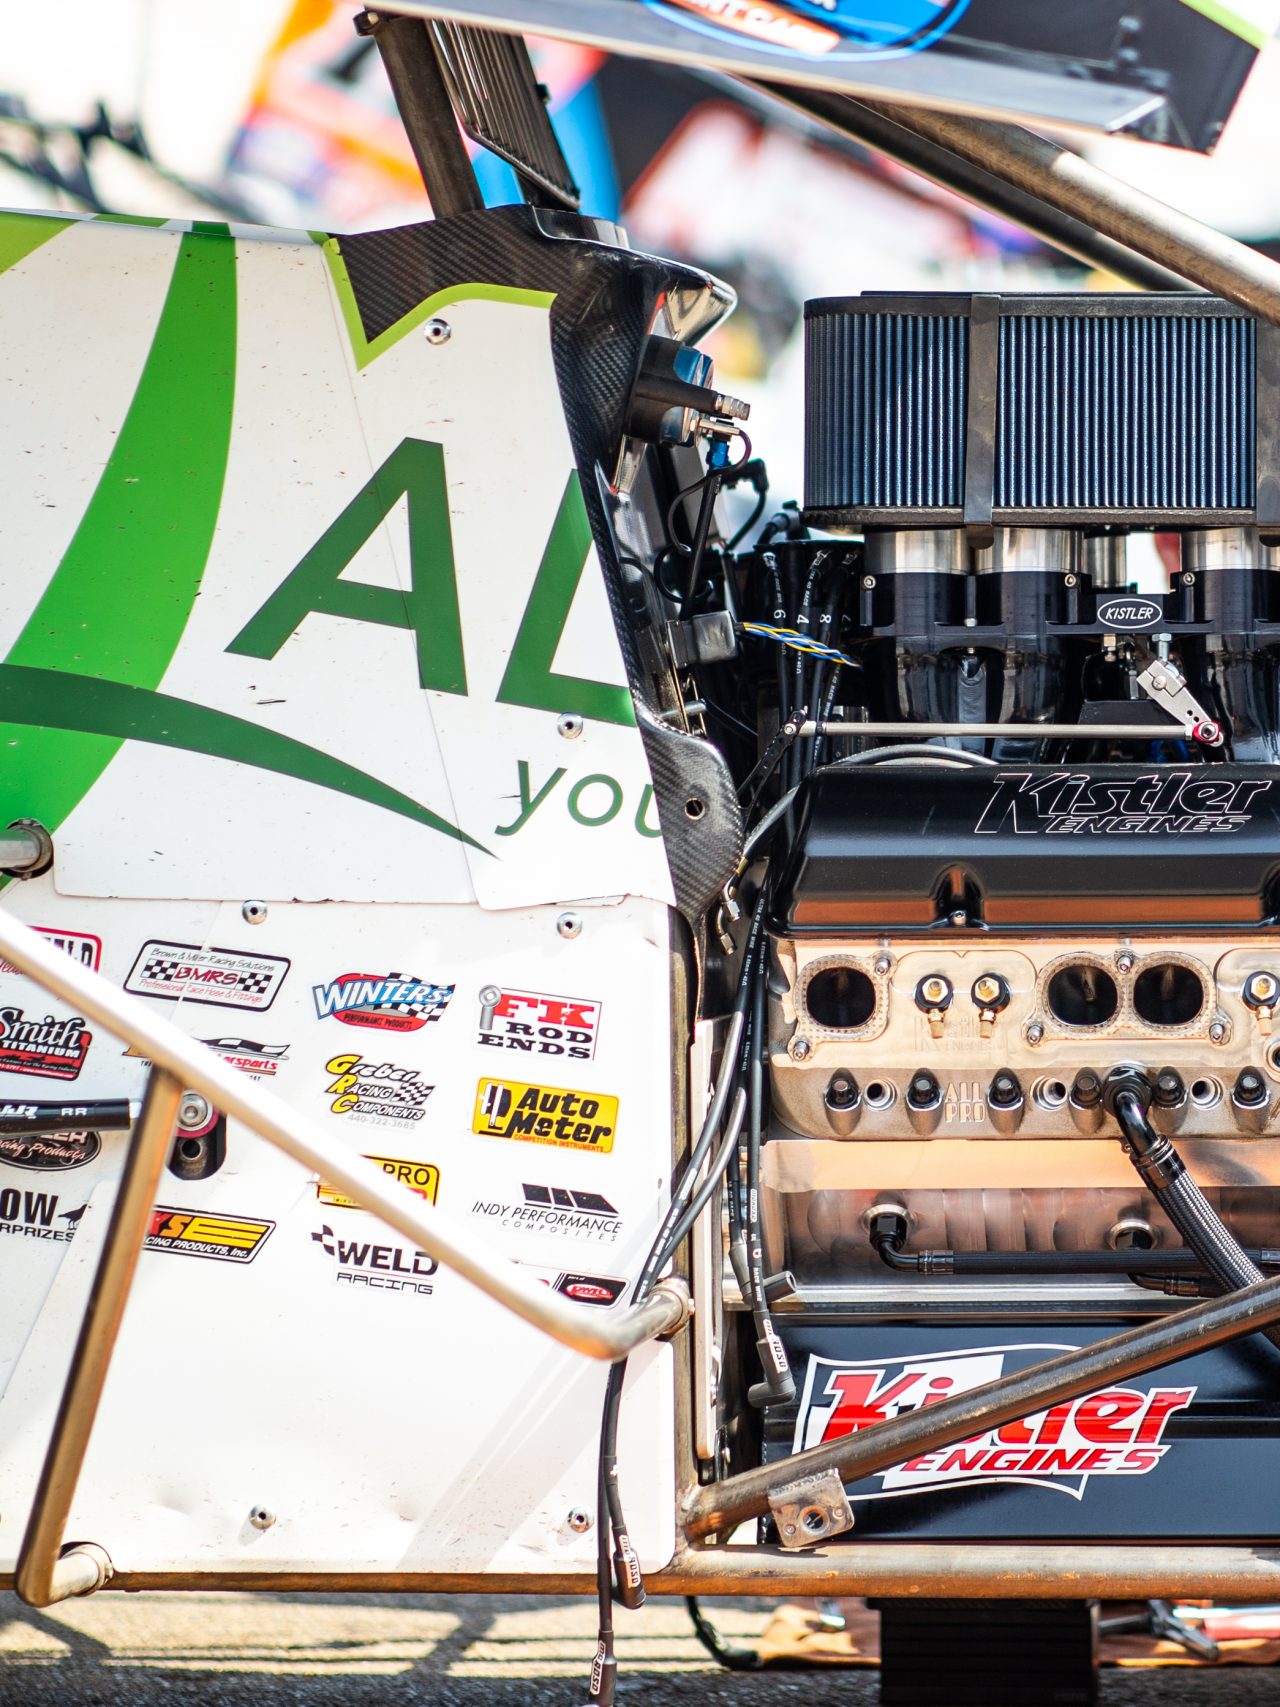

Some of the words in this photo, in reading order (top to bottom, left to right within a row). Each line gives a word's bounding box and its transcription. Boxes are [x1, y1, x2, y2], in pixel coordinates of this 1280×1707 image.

[773, 609, 786, 619] 6
[797, 614, 809, 625] 4
[819, 614, 831, 624] 8
[1105, 607, 1154, 620] KISTLER
[974, 772, 1273, 833] Kistler
[1045, 815, 1252, 833] ENGINES
[150, 948, 177, 960] Brown
[178, 952, 184, 960] &
[208, 955, 236, 968] Racing
[236, 959, 275, 972] Solutions
[175, 967, 238, 986] BMRS
[205, 986, 224, 998] Hose
[225, 990, 231, 998] &
[313, 980, 450, 1019] WINTERS
[493, 994, 595, 1029] FK
[0, 1008, 82, 1048] Smith
[505, 1021, 593, 1044] ROD
[2, 1040, 80, 1058] TITANIUM
[477, 1033, 591, 1059] ENDS
[325, 1053, 421, 1083] Greber
[324, 1073, 394, 1099] RACING
[945, 1082, 984, 1103] ALL
[61, 1107, 88, 1116] RR
[331, 1093, 426, 1121] COMPONENTS
[517, 1087, 600, 1119] Auto
[945, 1102, 986, 1123] PRO
[512, 1110, 612, 1144] Meter
[29, 1142, 86, 1160] Products
[513, 1133, 558, 1147] COMPETITION
[558, 1140, 604, 1153] INSTRUMENTS
[471, 1201, 510, 1217] INDY
[511, 1206, 623, 1234] PERFORMANCE
[501, 1219, 617, 1242] COMPOSITES
[171, 1239, 229, 1256] PRODUCTS,
[230, 1247, 248, 1258] Inc.
[338, 1240, 440, 1276] WELD
[336, 1272, 434, 1295] RACING
[820, 1373, 1197, 1446] Kitler
[900, 1449, 1167, 1472] ENGINES
